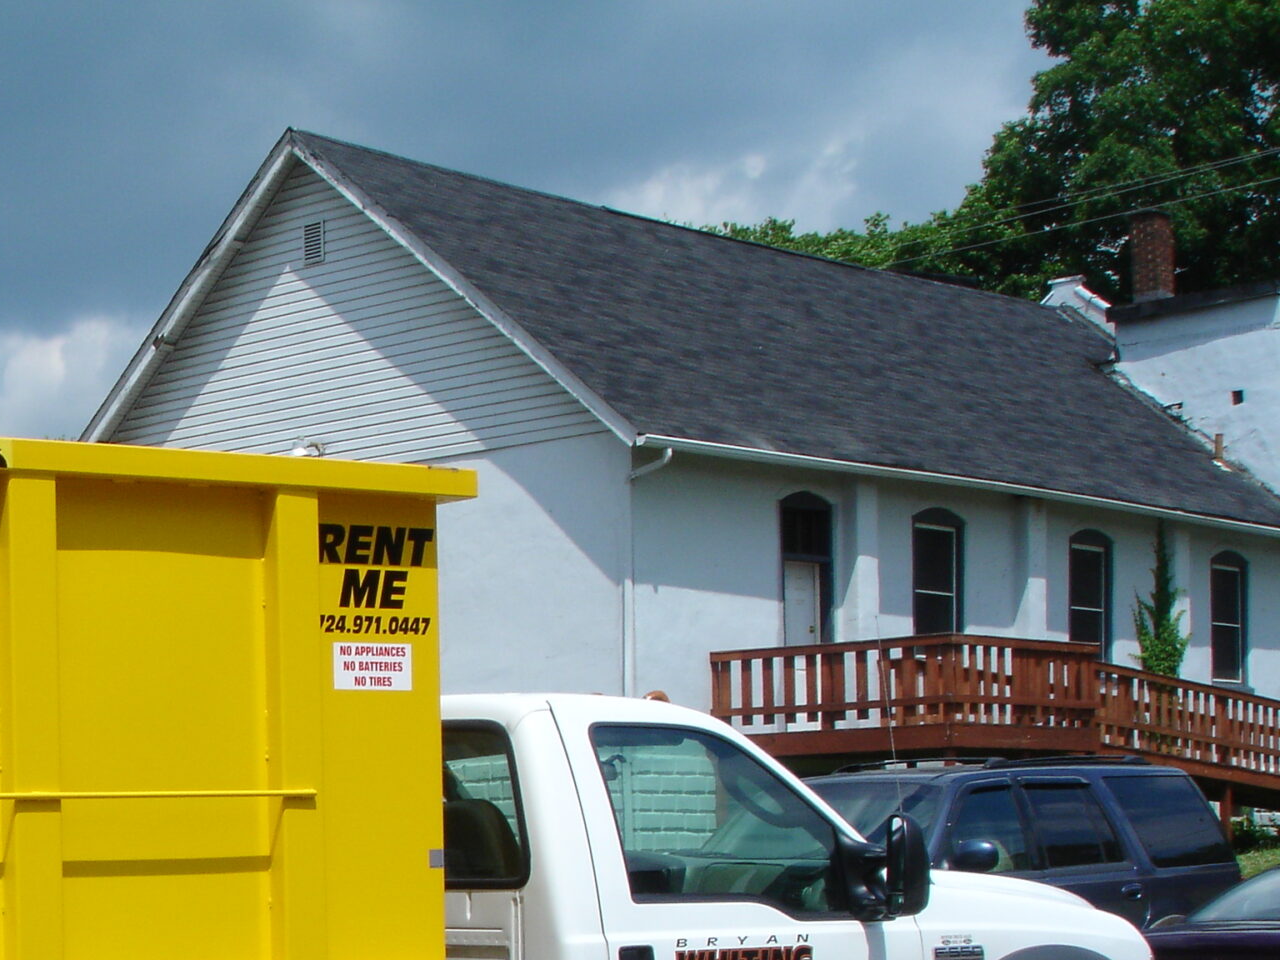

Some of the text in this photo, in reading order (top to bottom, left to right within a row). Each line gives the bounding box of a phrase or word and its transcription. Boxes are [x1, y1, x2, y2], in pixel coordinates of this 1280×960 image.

[319, 523, 434, 567] RENT
[339, 568, 409, 610] ME
[339, 645, 407, 658] NO APPLIANCES
[343, 660, 403, 673] NO BATTERIES
[354, 675, 393, 687] NO TIRES
